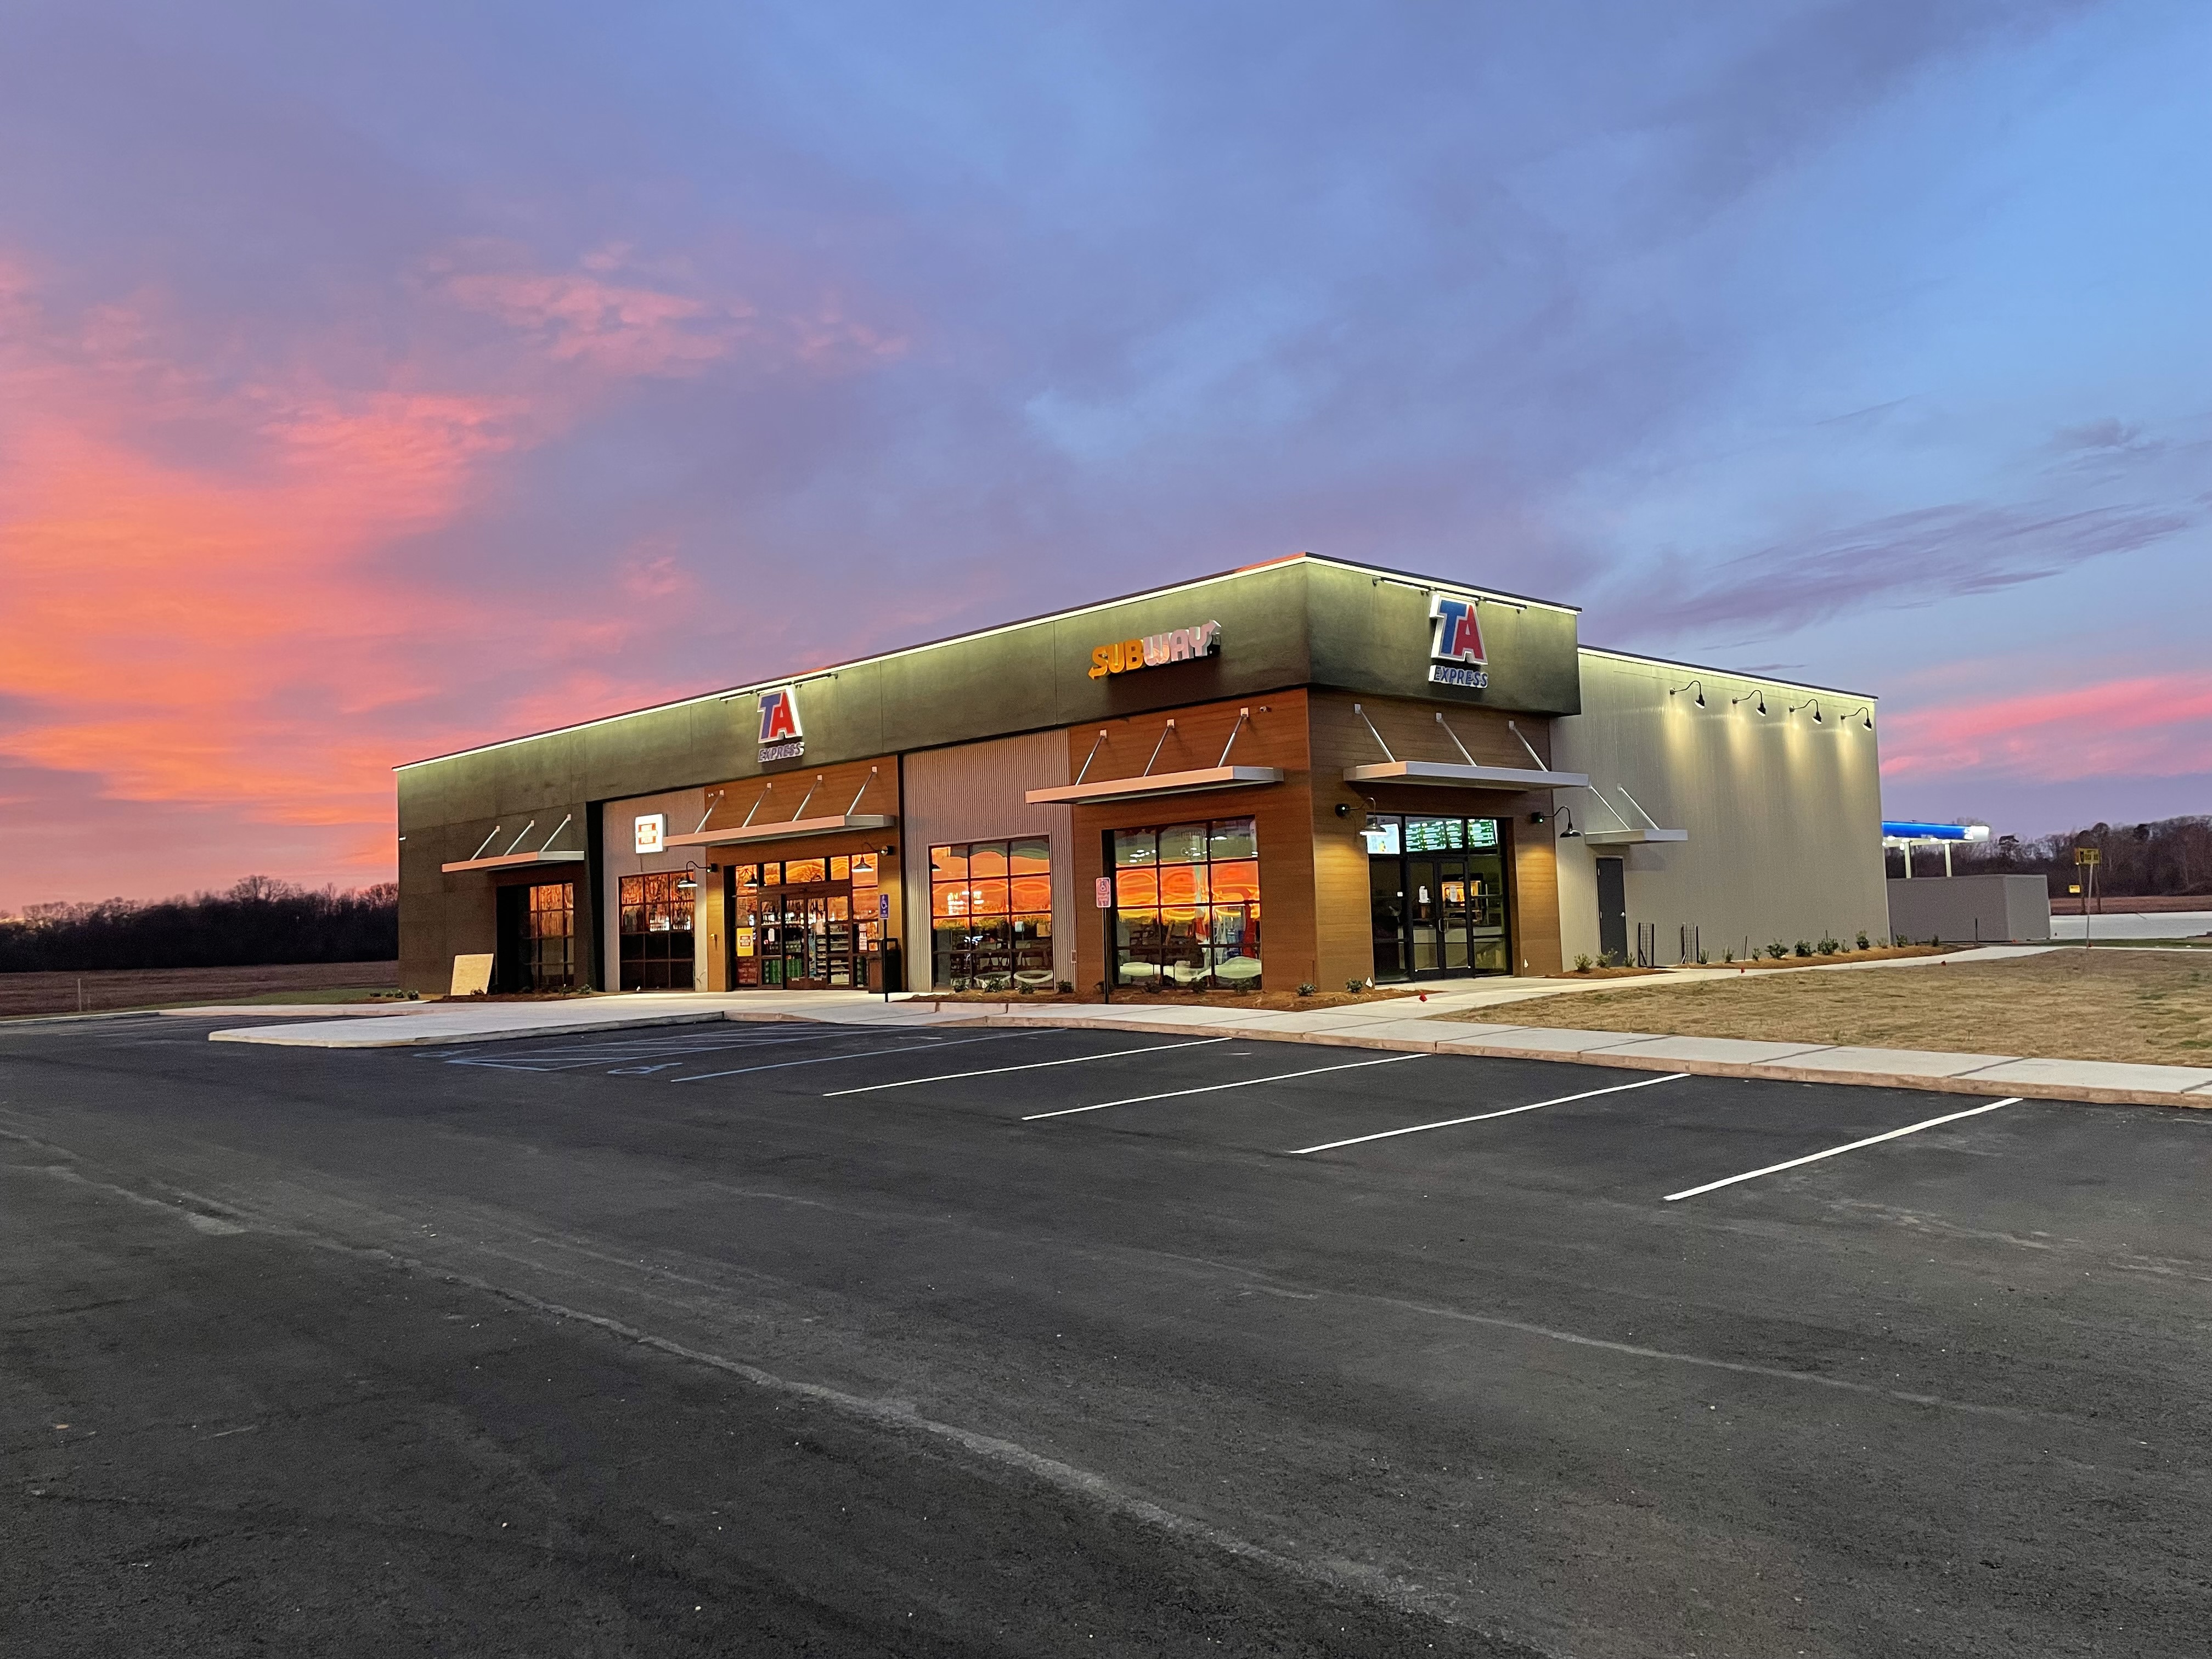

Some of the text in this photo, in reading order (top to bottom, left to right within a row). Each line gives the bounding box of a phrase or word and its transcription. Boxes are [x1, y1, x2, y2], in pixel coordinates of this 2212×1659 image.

[1088, 620, 1221, 679] SUBWAY
[1432, 595, 1487, 664] TA
[1431, 665, 1488, 688] EXPRESS
[758, 689, 799, 742] TA
[758, 742, 804, 761] EXPRESS
